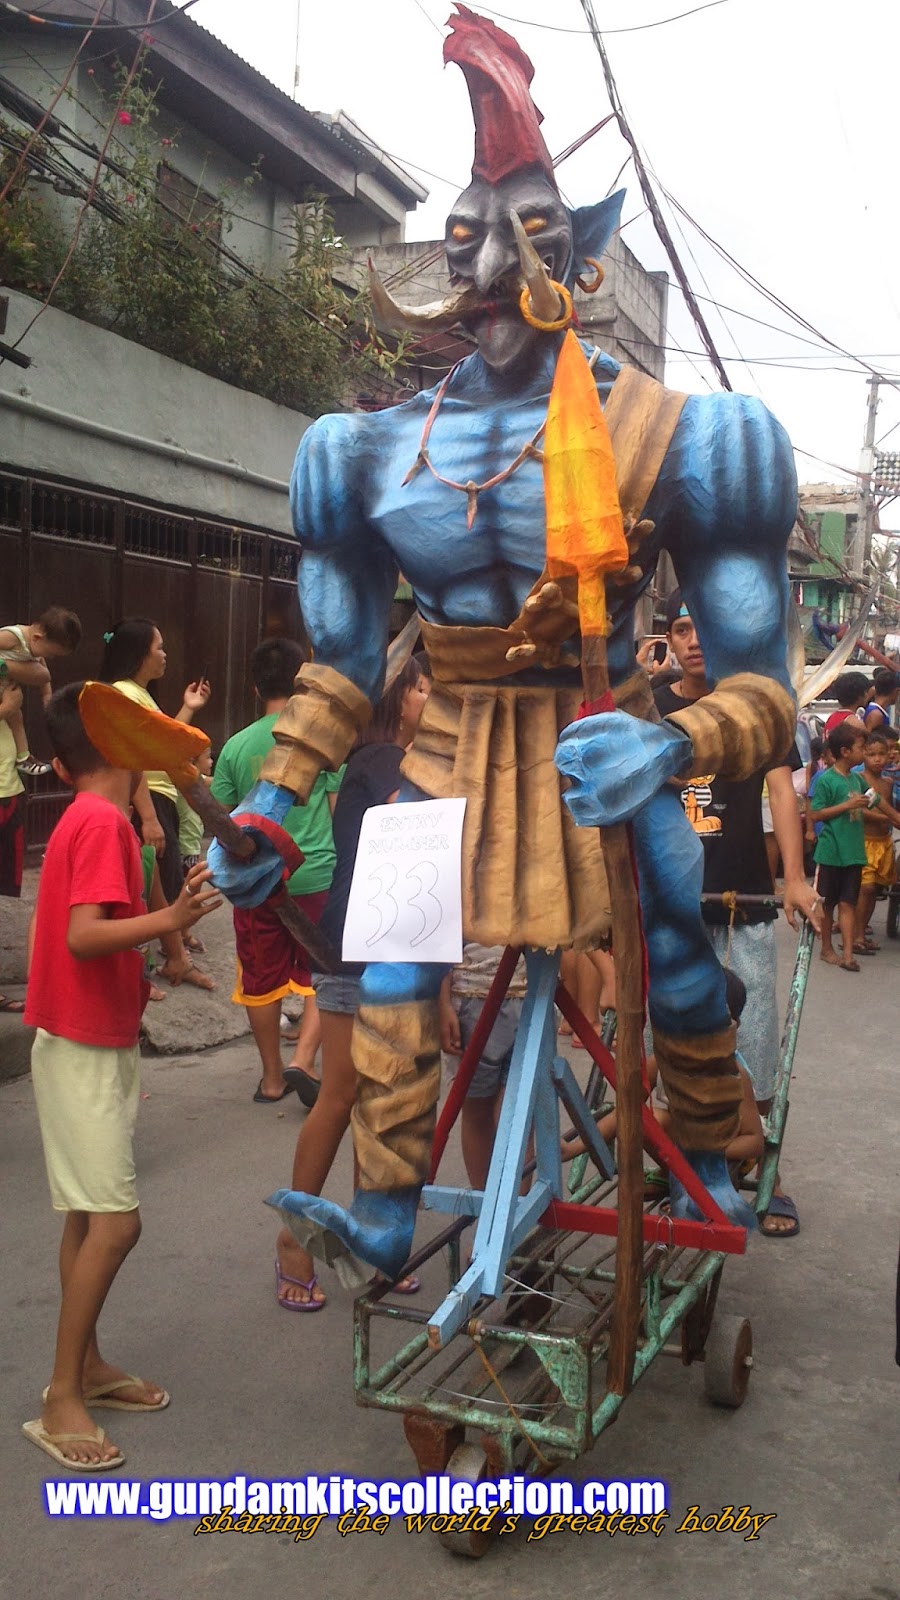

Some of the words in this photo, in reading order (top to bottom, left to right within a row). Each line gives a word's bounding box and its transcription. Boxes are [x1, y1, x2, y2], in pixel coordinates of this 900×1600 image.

[380, 811, 444, 832] ENTRY
[368, 834, 450, 855] NUMBER
[366, 861, 442, 947] 33
